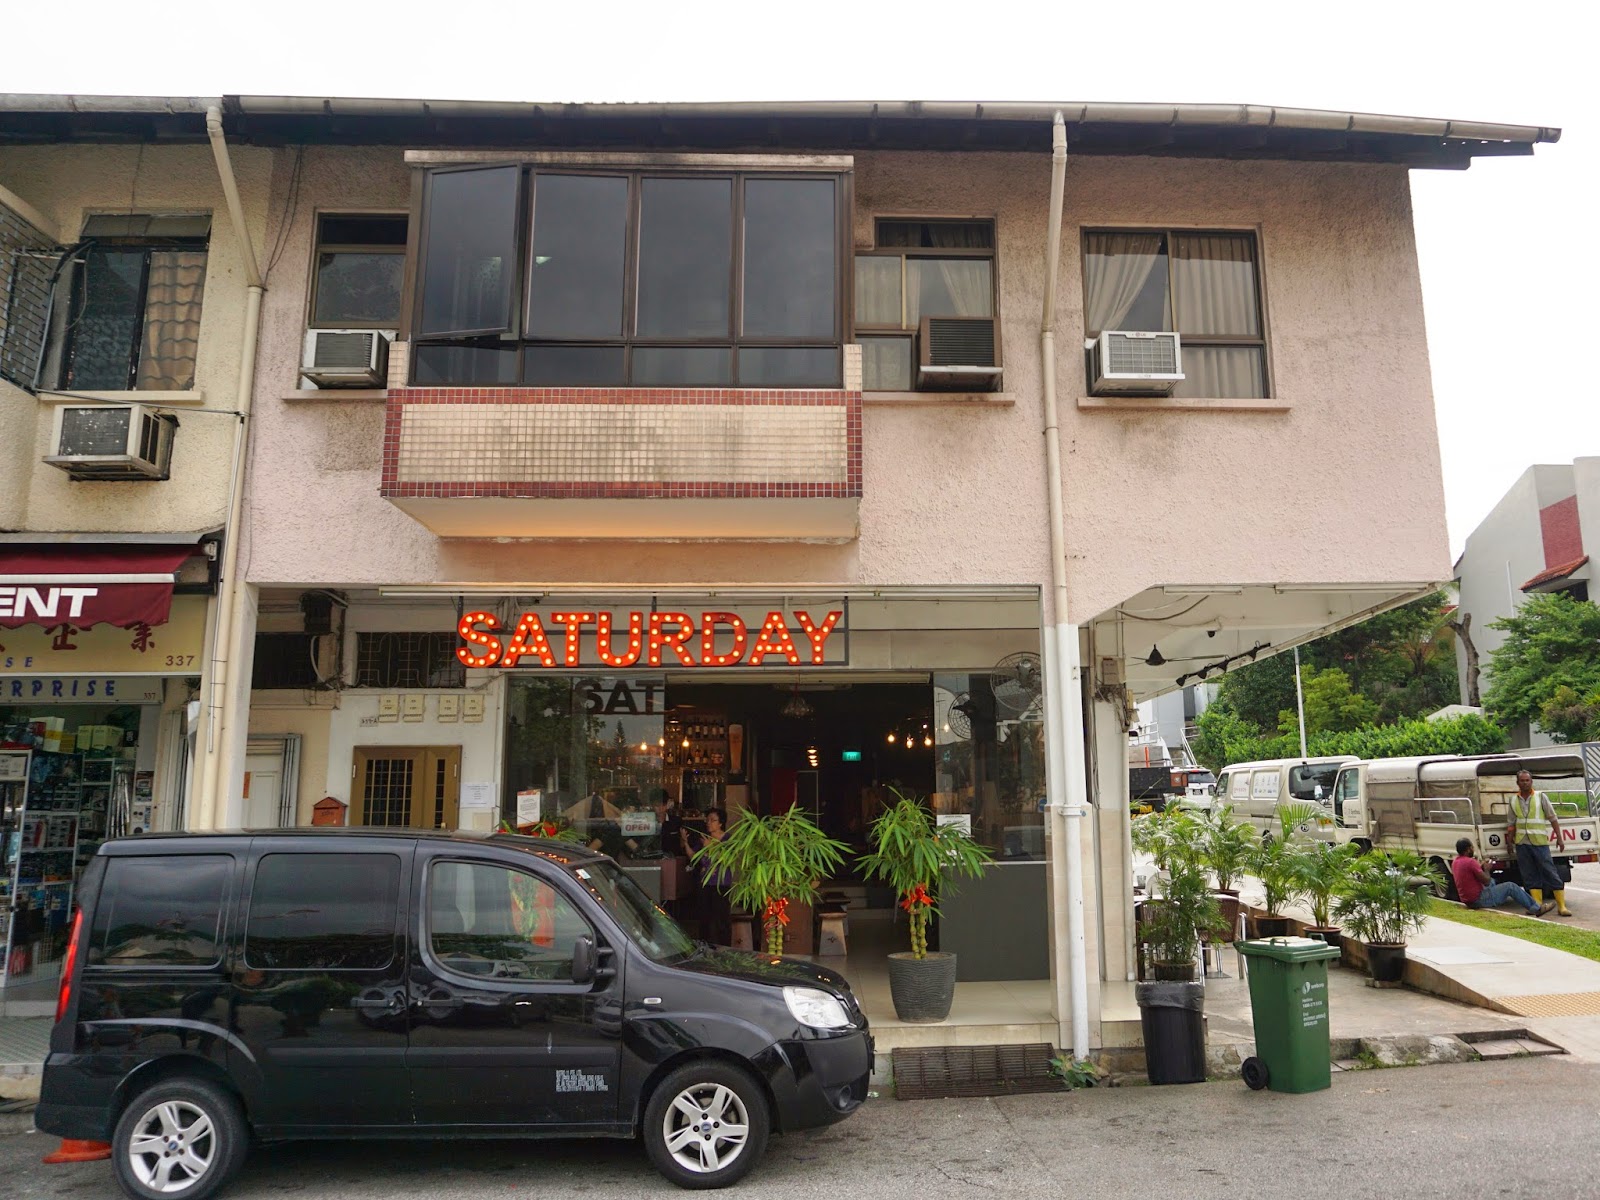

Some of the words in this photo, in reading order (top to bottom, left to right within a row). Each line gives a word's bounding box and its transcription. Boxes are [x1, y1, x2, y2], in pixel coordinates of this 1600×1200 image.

[456, 611, 843, 668] SATURDAY
[165, 655, 195, 666] 337
[0, 680, 115, 697] RPRISE
[625, 823, 650, 832] OPEN
